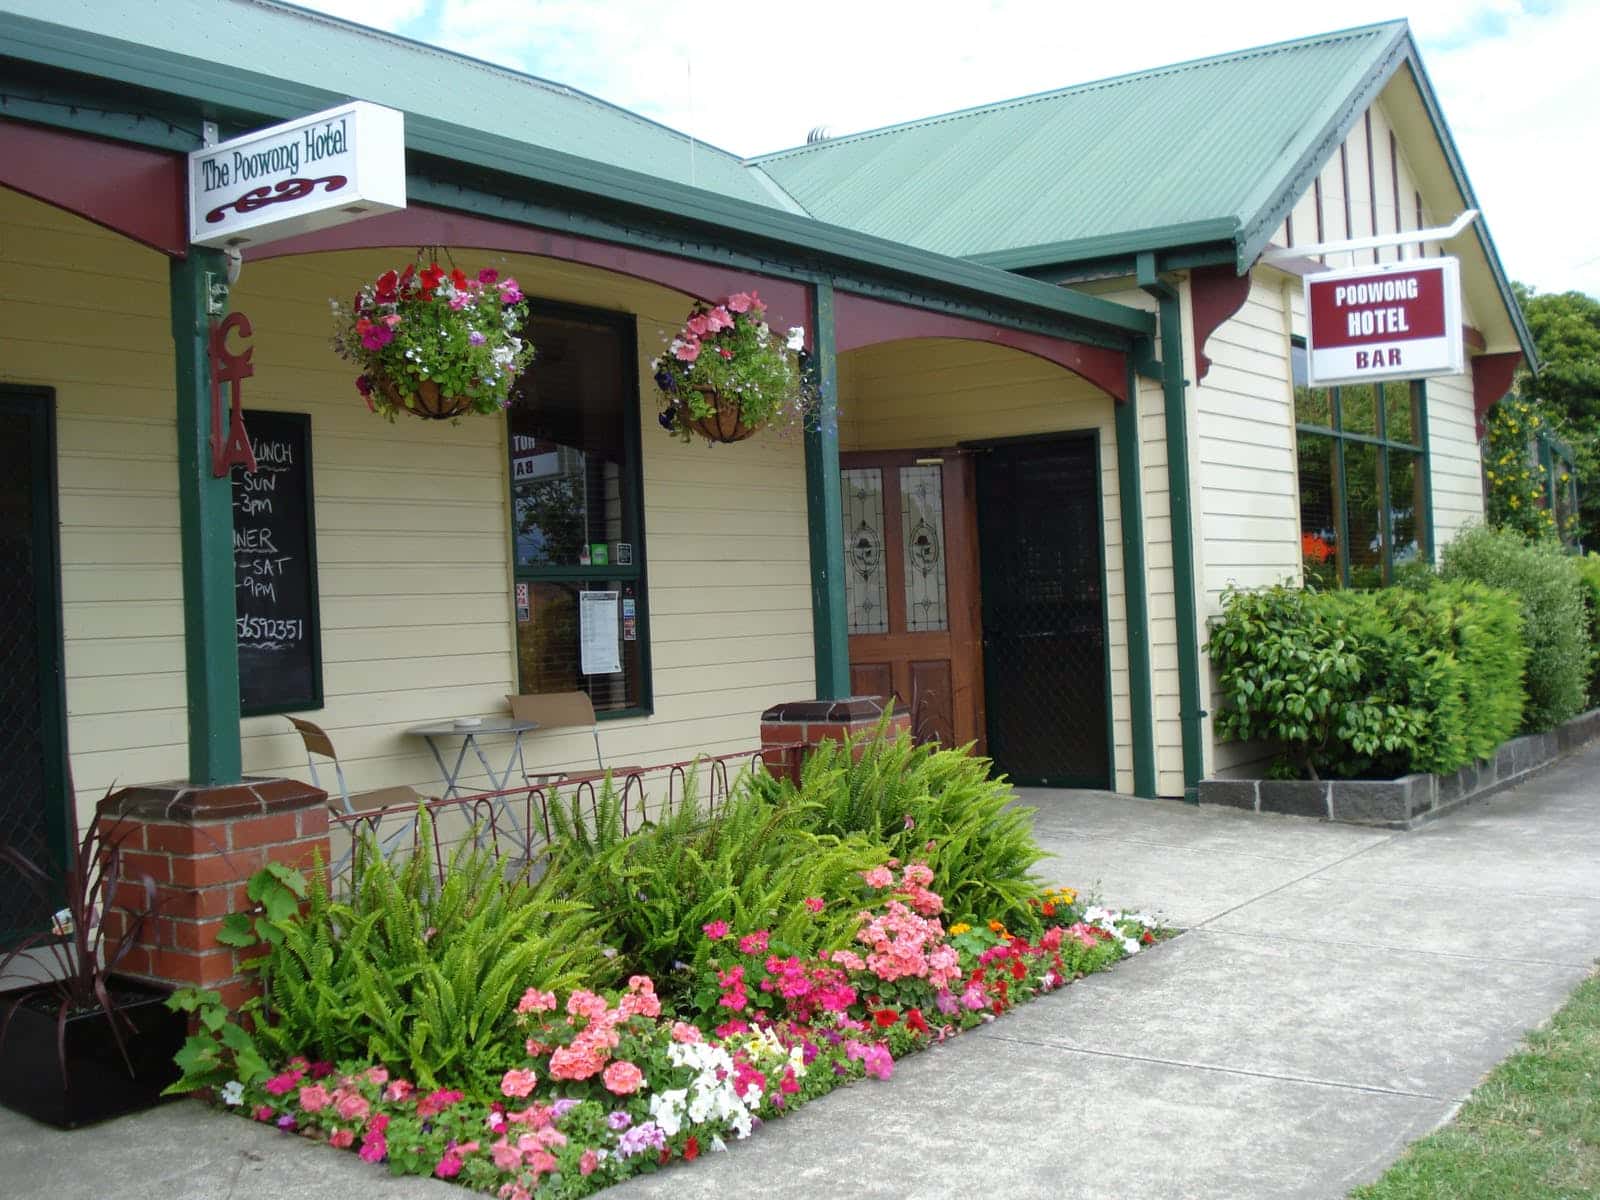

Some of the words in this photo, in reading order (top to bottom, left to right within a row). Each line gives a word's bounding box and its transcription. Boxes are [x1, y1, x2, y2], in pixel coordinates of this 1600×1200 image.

[202, 158, 230, 192] The
[233, 141, 300, 184] Poowong
[304, 119, 348, 164] Hotel
[1335, 278, 1418, 307] POOWONG
[1348, 307, 1409, 337] HOTEL
[1356, 348, 1402, 370] BAR
[233, 527, 278, 551] NER
